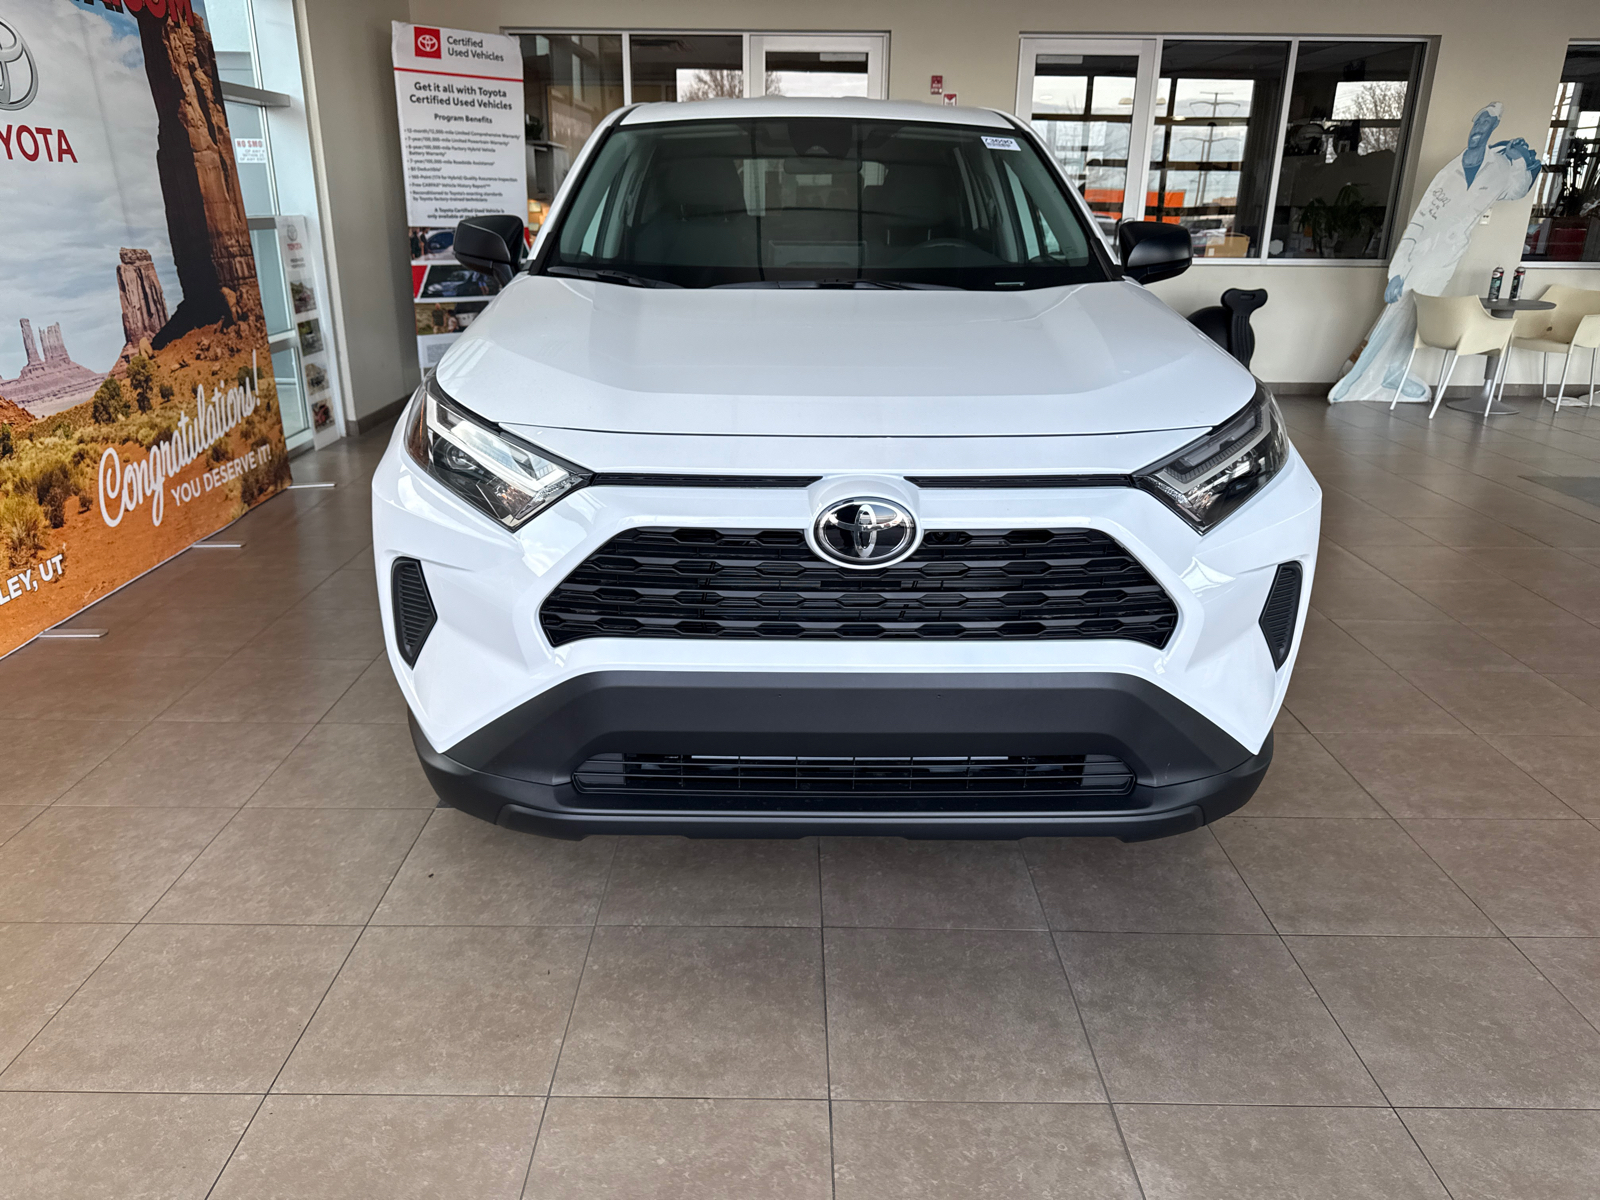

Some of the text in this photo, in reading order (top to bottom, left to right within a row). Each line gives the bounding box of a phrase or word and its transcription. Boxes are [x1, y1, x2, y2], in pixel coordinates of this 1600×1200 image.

[447, 36, 483, 48] Certified
[448, 48, 504, 62] Used Vehicles
[414, 82, 507, 98] Get it all with Toyota
[410, 94, 512, 110] Certified Used Vehicles
[434, 113, 492, 124] Program Benefits
[98, 349, 260, 527] Congratulations!
[171, 444, 272, 506] YOU DESERVE IT!
[0, 554, 63, 606] LEY, UT
